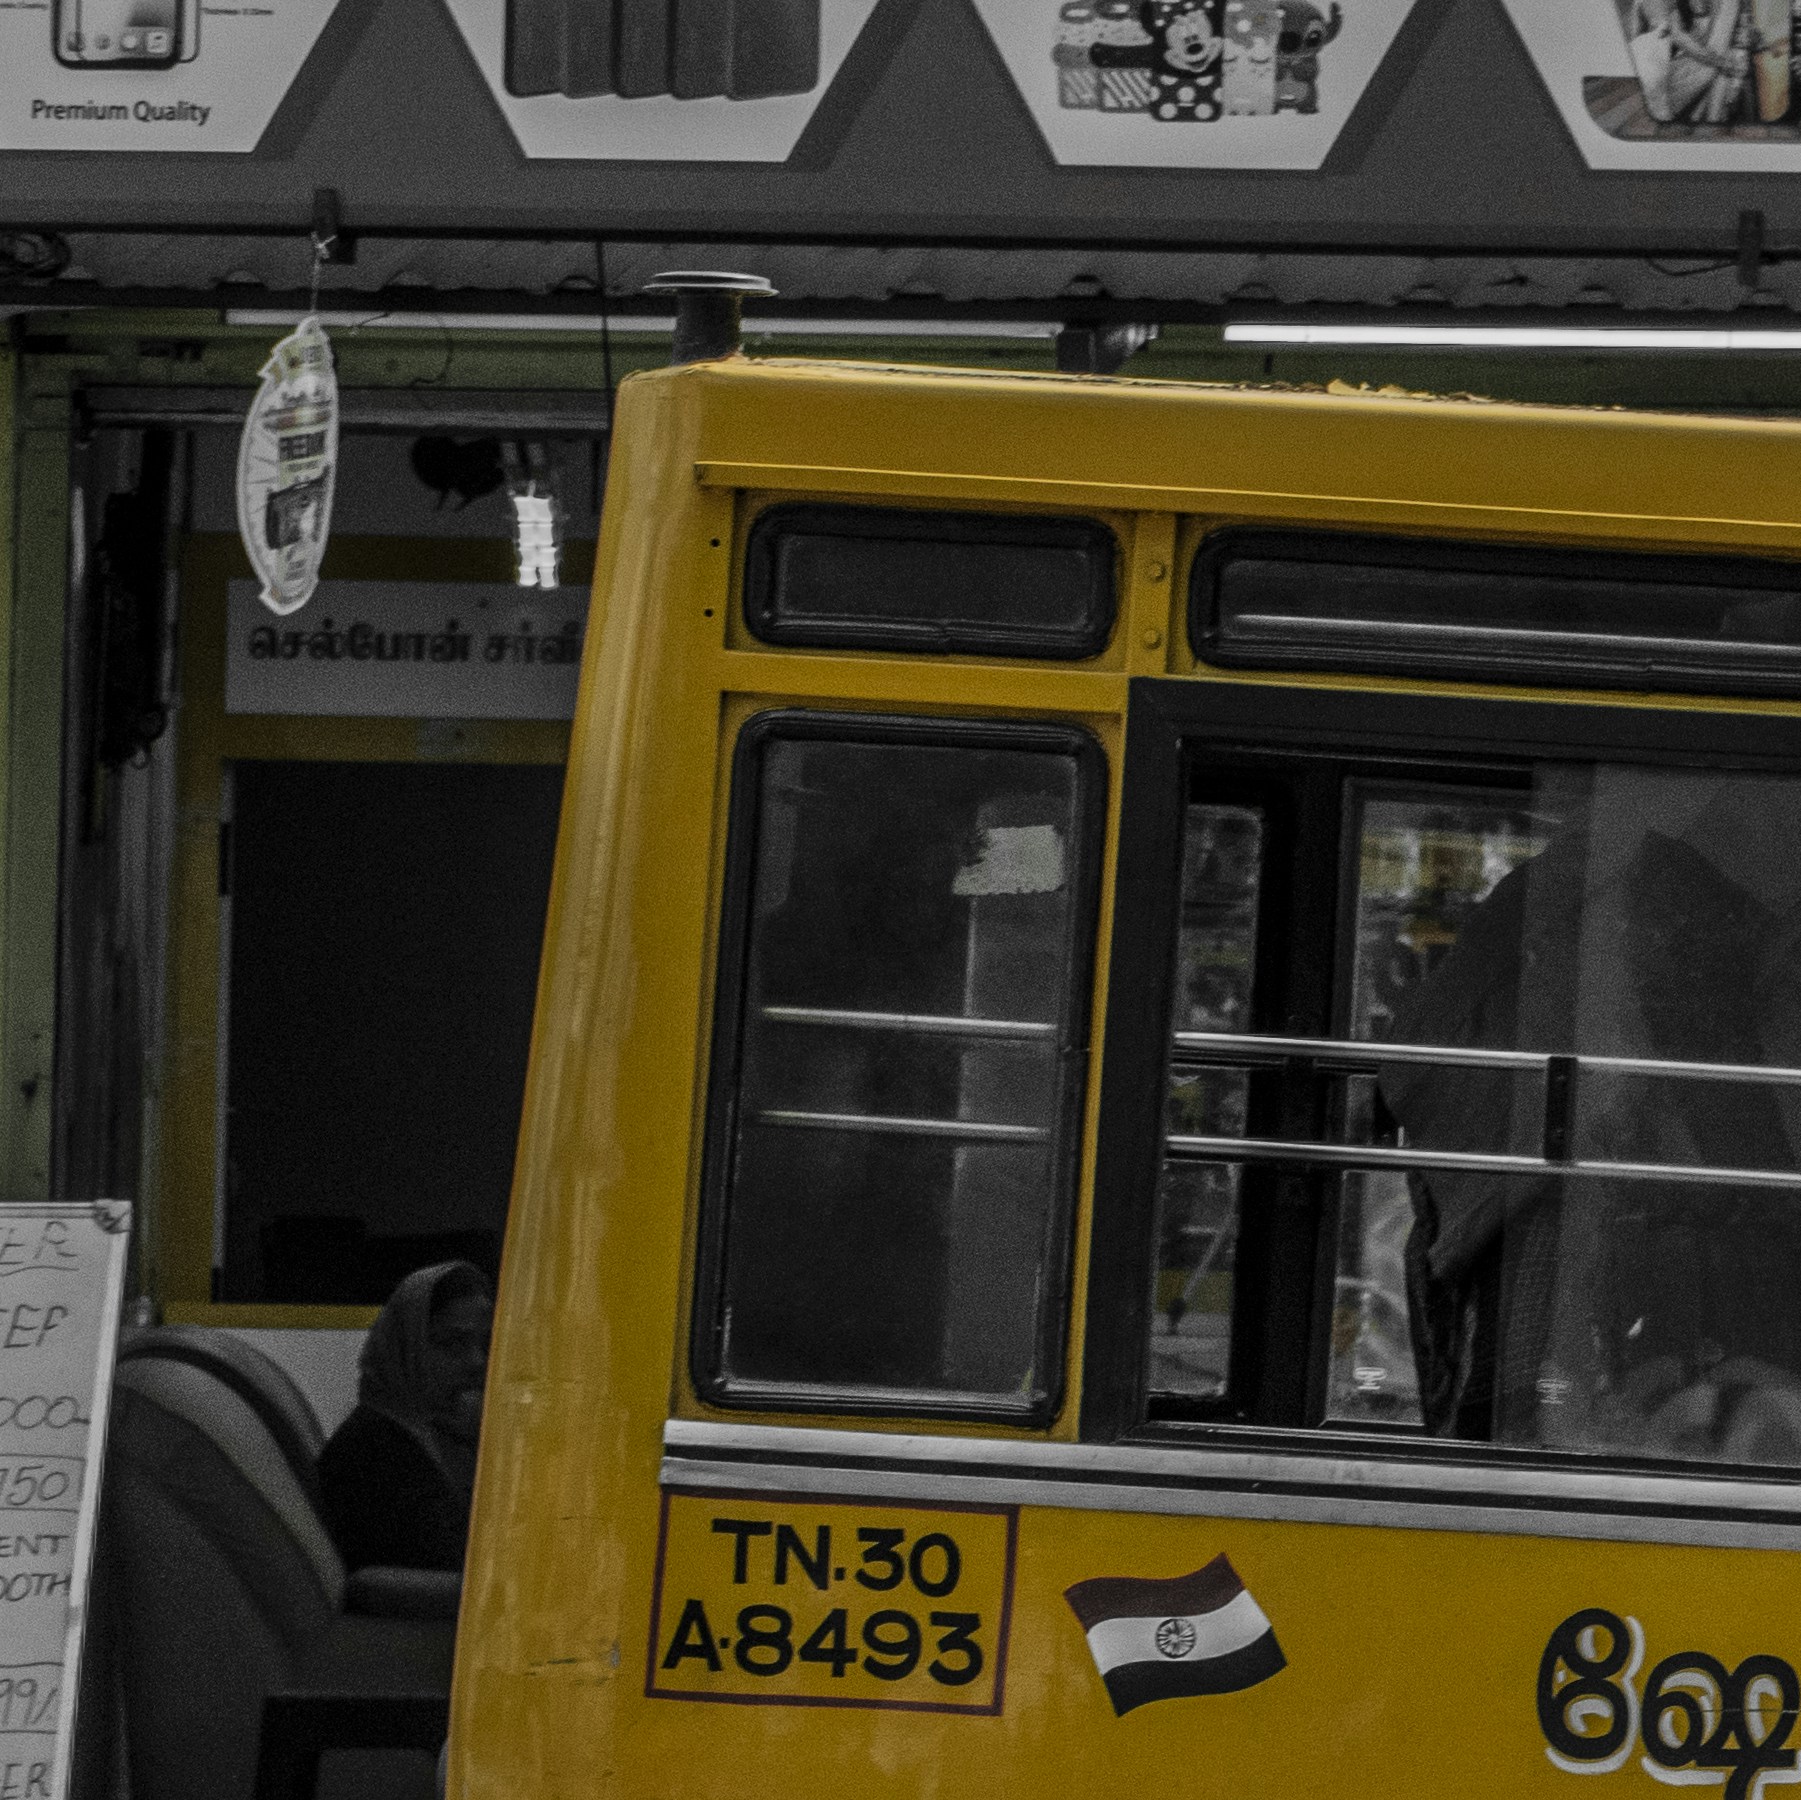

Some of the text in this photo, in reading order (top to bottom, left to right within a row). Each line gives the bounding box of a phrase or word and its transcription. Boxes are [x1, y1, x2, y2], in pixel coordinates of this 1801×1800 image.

[31, 99, 211, 126] Premium Quality
[711, 1518, 961, 1598] TN.30
